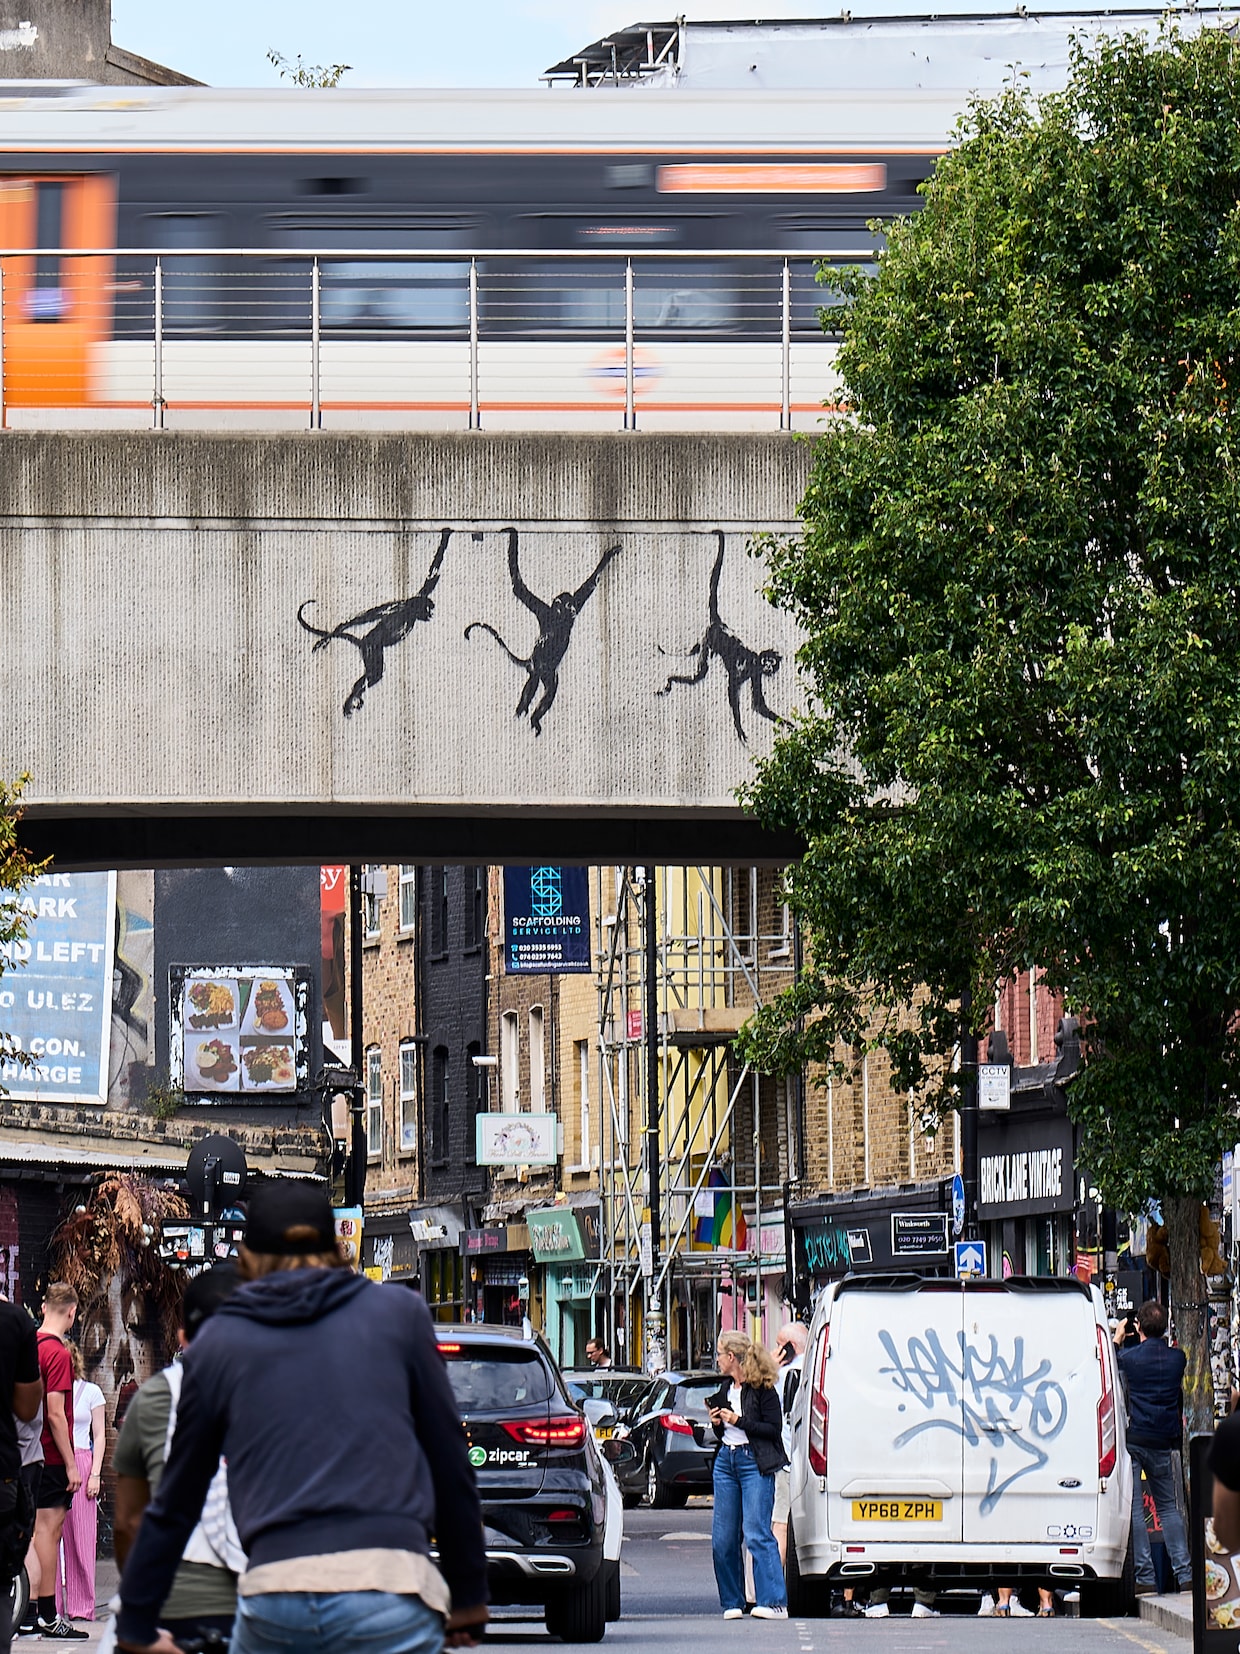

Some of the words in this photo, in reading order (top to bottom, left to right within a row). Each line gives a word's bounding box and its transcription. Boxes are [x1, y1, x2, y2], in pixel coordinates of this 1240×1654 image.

[512, 916, 581, 927] SCAFFOLDING
[512, 927, 558, 936] SERVICE
[562, 927, 581, 935] LTD
[36, 941, 105, 963] LEFT
[27, 989, 94, 1011] ULEZ
[29, 1038, 86, 1058] CON.
[981, 1067, 1007, 1075] CCTV
[980, 1155, 1005, 1204] BRICK
[1006, 1153, 1028, 1202] LANE
[1028, 1147, 1062, 1199] VINTAGE
[1116, 1301, 1134, 1310] AGE
[488, 1447, 530, 1465] zipcar
[859, 1503, 899, 1518] YP68
[904, 1503, 935, 1518] ZPH
